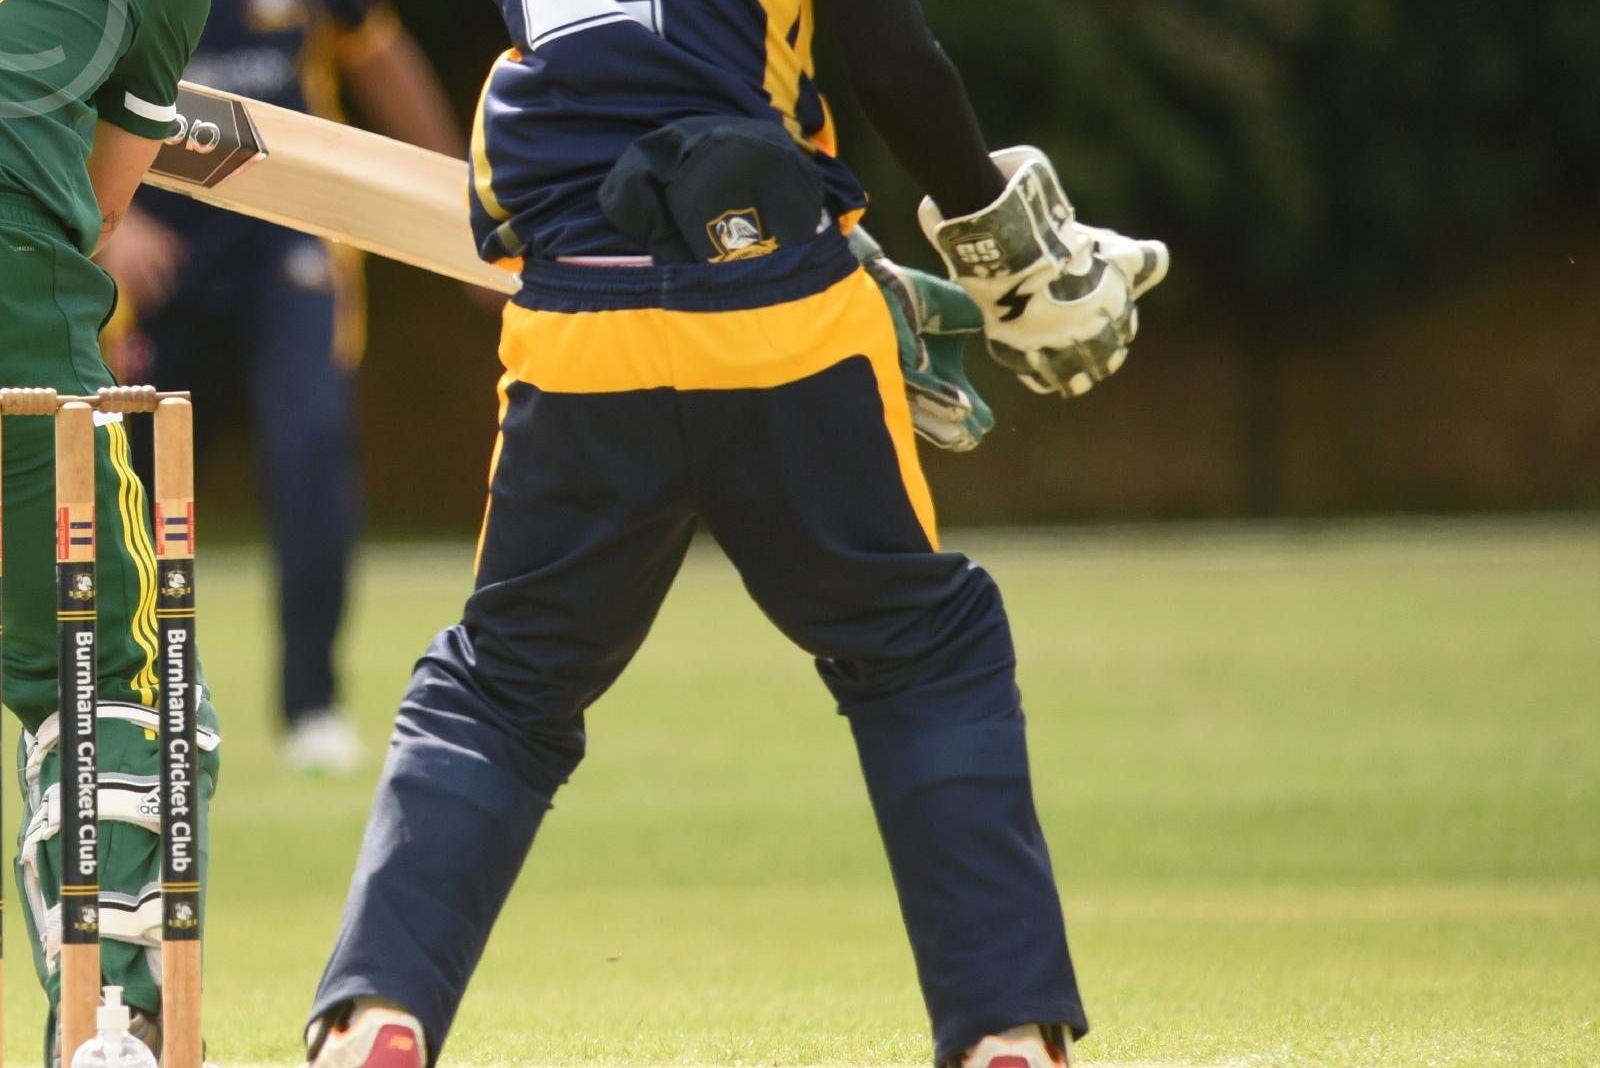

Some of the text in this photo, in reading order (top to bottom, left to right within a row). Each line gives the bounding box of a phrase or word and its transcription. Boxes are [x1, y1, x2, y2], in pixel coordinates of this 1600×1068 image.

[75, 631, 98, 875] Burnham Cricket Club
[166, 628, 192, 873] Burnham Cricket Club
